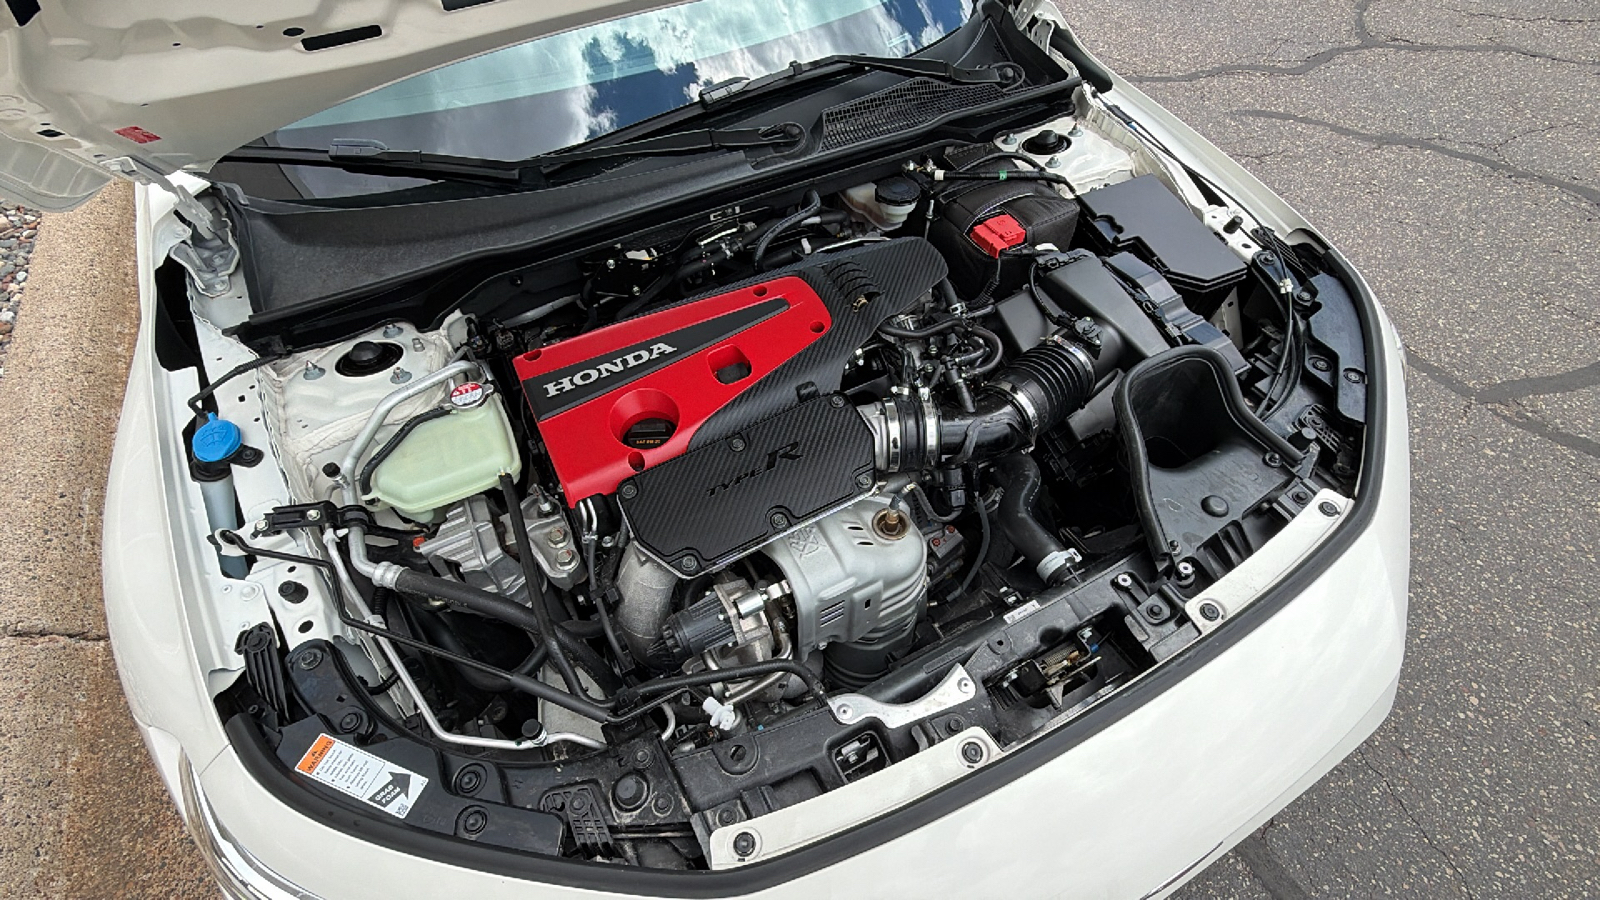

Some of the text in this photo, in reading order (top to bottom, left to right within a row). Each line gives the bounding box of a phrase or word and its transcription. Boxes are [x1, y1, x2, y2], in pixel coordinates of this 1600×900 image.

[543, 342, 677, 397] HONDA
[706, 441, 804, 497] TYPE R
[307, 740, 333, 772] WARNING
[375, 784, 394, 801] GRAB
[381, 786, 401, 804] FOAM
